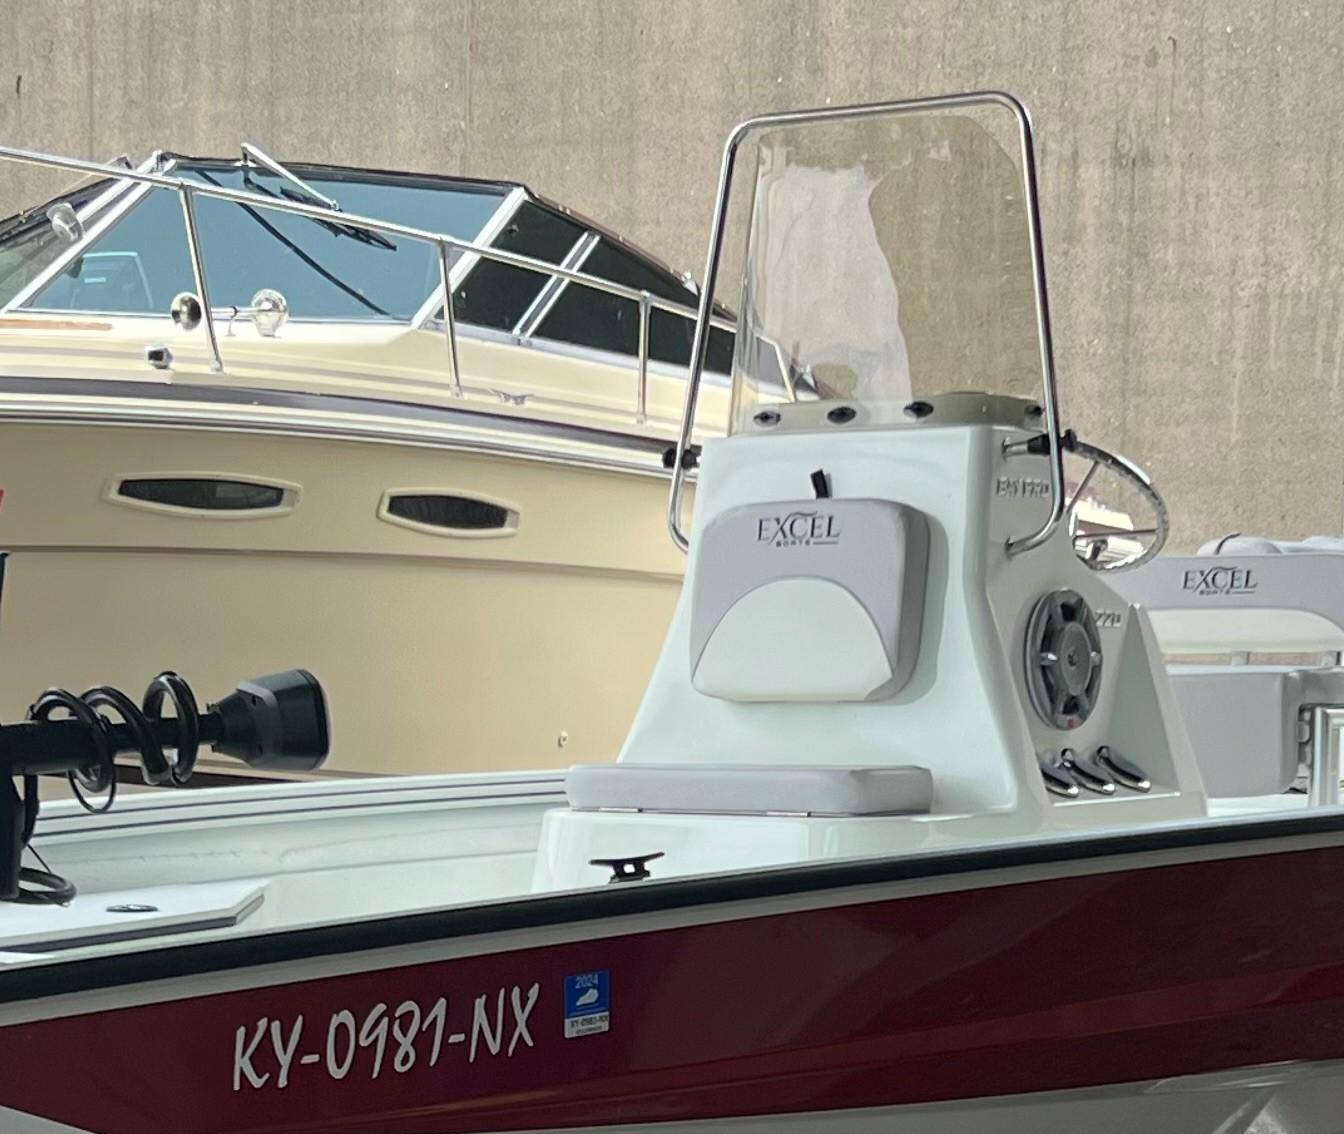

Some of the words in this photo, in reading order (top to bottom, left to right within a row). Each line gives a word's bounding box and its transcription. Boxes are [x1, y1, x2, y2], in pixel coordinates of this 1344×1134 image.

[757, 511, 841, 544] EXCEL
[1183, 566, 1259, 593] EXCEL
[233, 983, 540, 1091] KY-0981-NX
